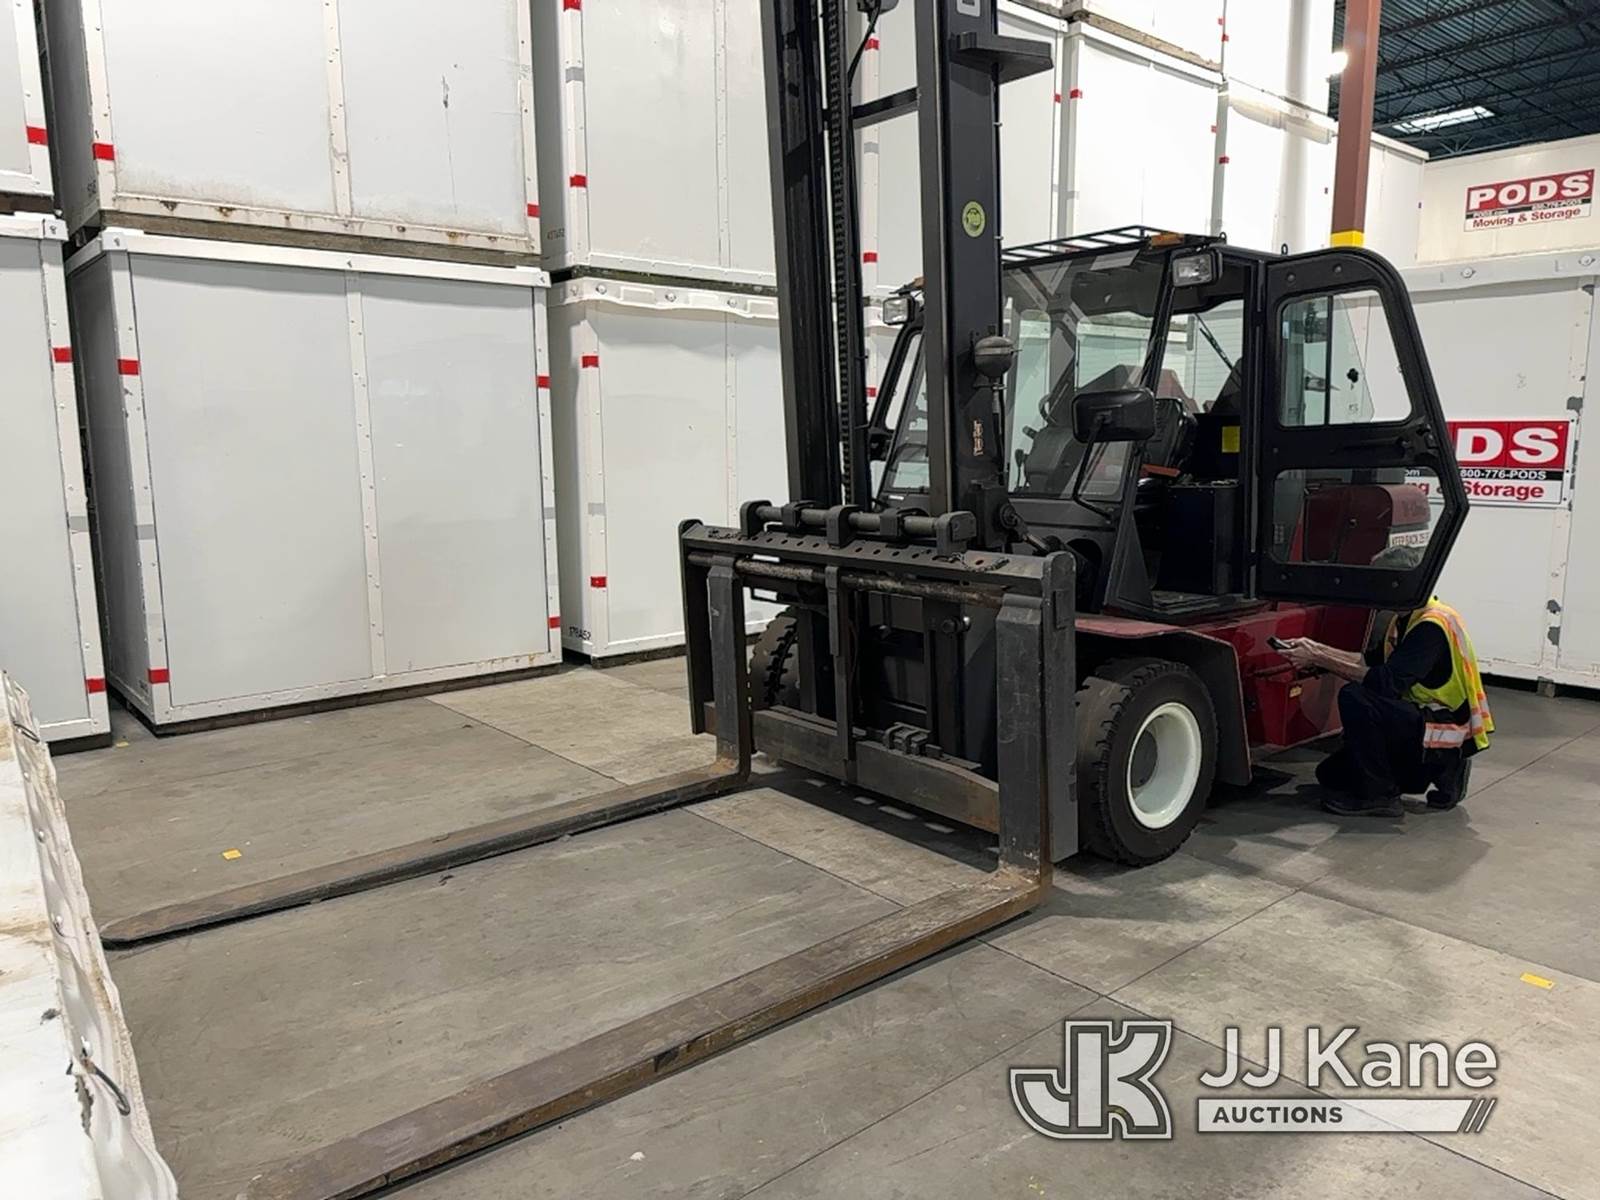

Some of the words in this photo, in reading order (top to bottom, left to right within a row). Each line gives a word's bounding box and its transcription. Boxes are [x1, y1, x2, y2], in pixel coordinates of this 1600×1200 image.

[1468, 174, 1590, 210] PODS
[1472, 215, 1514, 228] Moving
[1518, 213, 1527, 223] &
[1531, 208, 1581, 221] Storage
[1455, 427, 1560, 464] DS
[1460, 469, 1547, 481] 800-776-PODS
[1463, 480, 1545, 501] Storage
